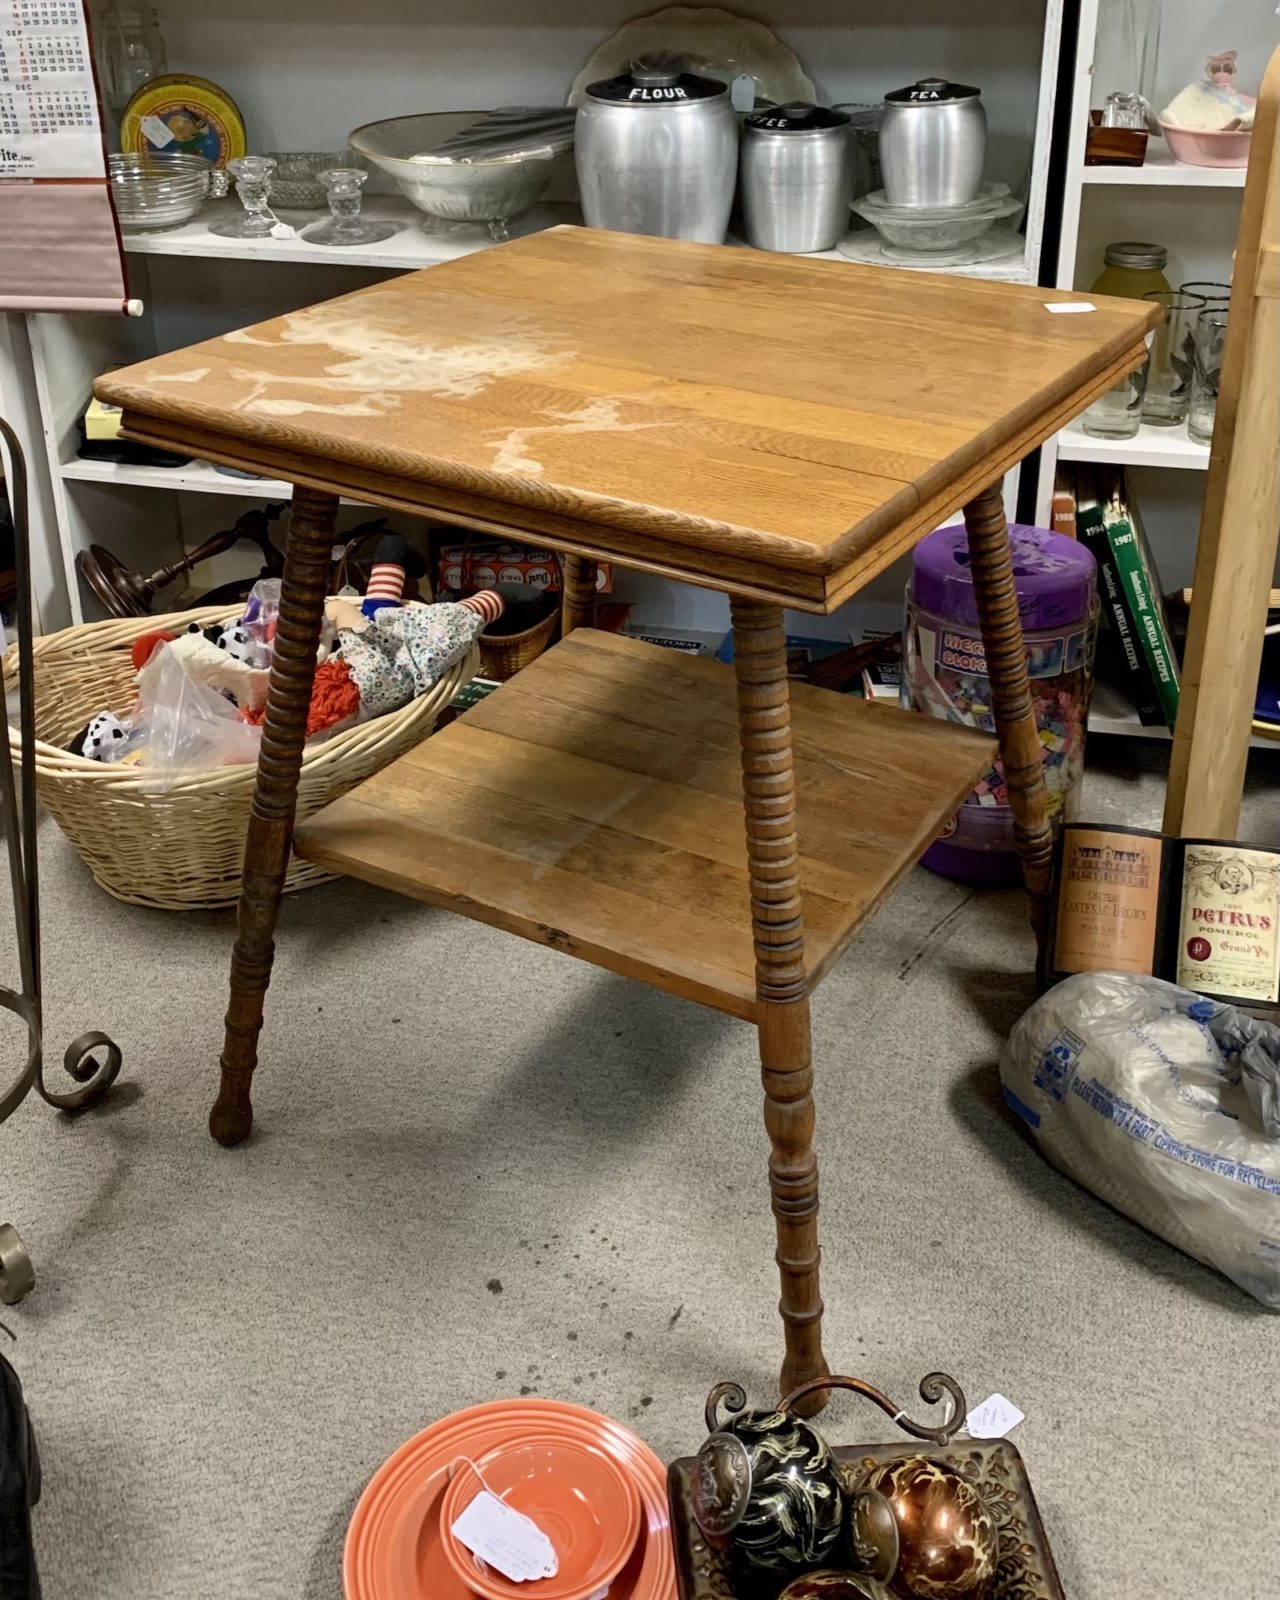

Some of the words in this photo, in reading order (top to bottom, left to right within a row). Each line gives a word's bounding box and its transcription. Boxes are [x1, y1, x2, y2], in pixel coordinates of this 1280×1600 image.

[628, 88, 688, 99] FLOUR
[1054, 513, 1074, 521] 1988
[1086, 524, 1104, 536] 1994
[1114, 534, 1132, 546] 1987
[944, 634, 985, 656] MEG
[1113, 604, 1130, 636] ANNUAL
[1122, 636, 1139, 670] RECIPES
[1143, 615, 1159, 648] ANNUAL
[1153, 649, 1170, 682] RECIPES
[943, 652, 988, 672] BLOK
[1113, 904, 1148, 920] BROWN
[1199, 927, 1260, 939] POMEROL
[1192, 1154, 1217, 1171] STORE
[1218, 1162, 1235, 1178] FOR
